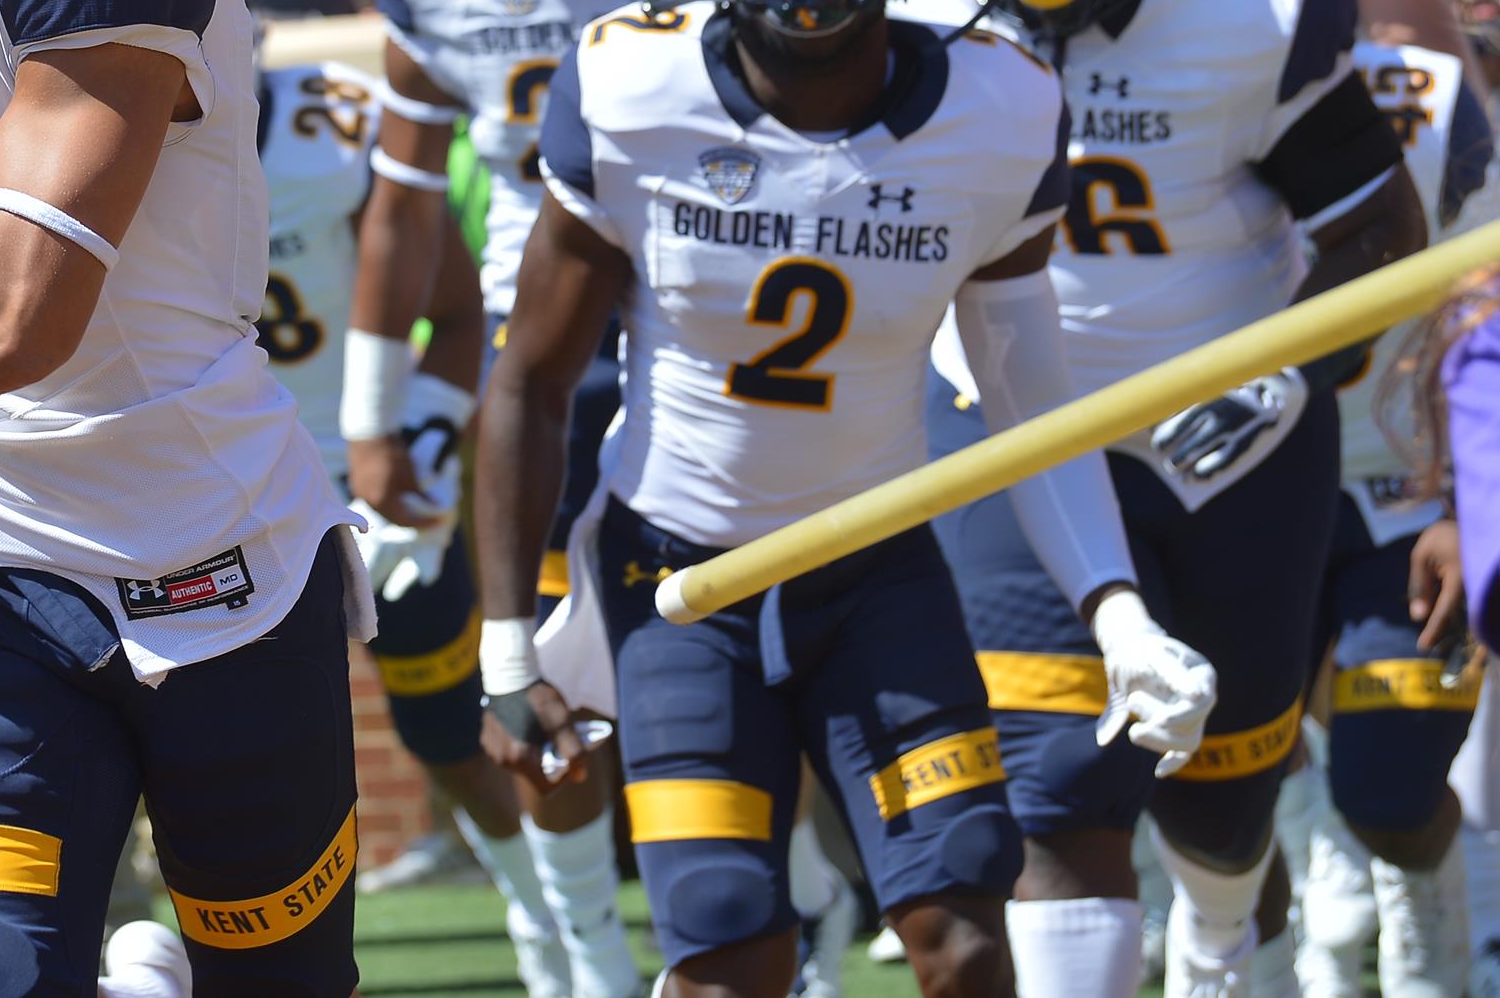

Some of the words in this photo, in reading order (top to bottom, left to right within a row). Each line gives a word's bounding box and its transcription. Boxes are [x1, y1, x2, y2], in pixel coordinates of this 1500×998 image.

[1071, 109, 1171, 144] ASHES
[673, 201, 795, 250] GOLDEN
[815, 216, 950, 263] FLASHES
[723, 255, 854, 412] 2
[196, 554, 235, 572] ARMOUR
[219, 573, 238, 586] MD
[171, 581, 213, 600] AUTHENTIC
[196, 906, 270, 934] KENT
[283, 845, 346, 917] STATE
